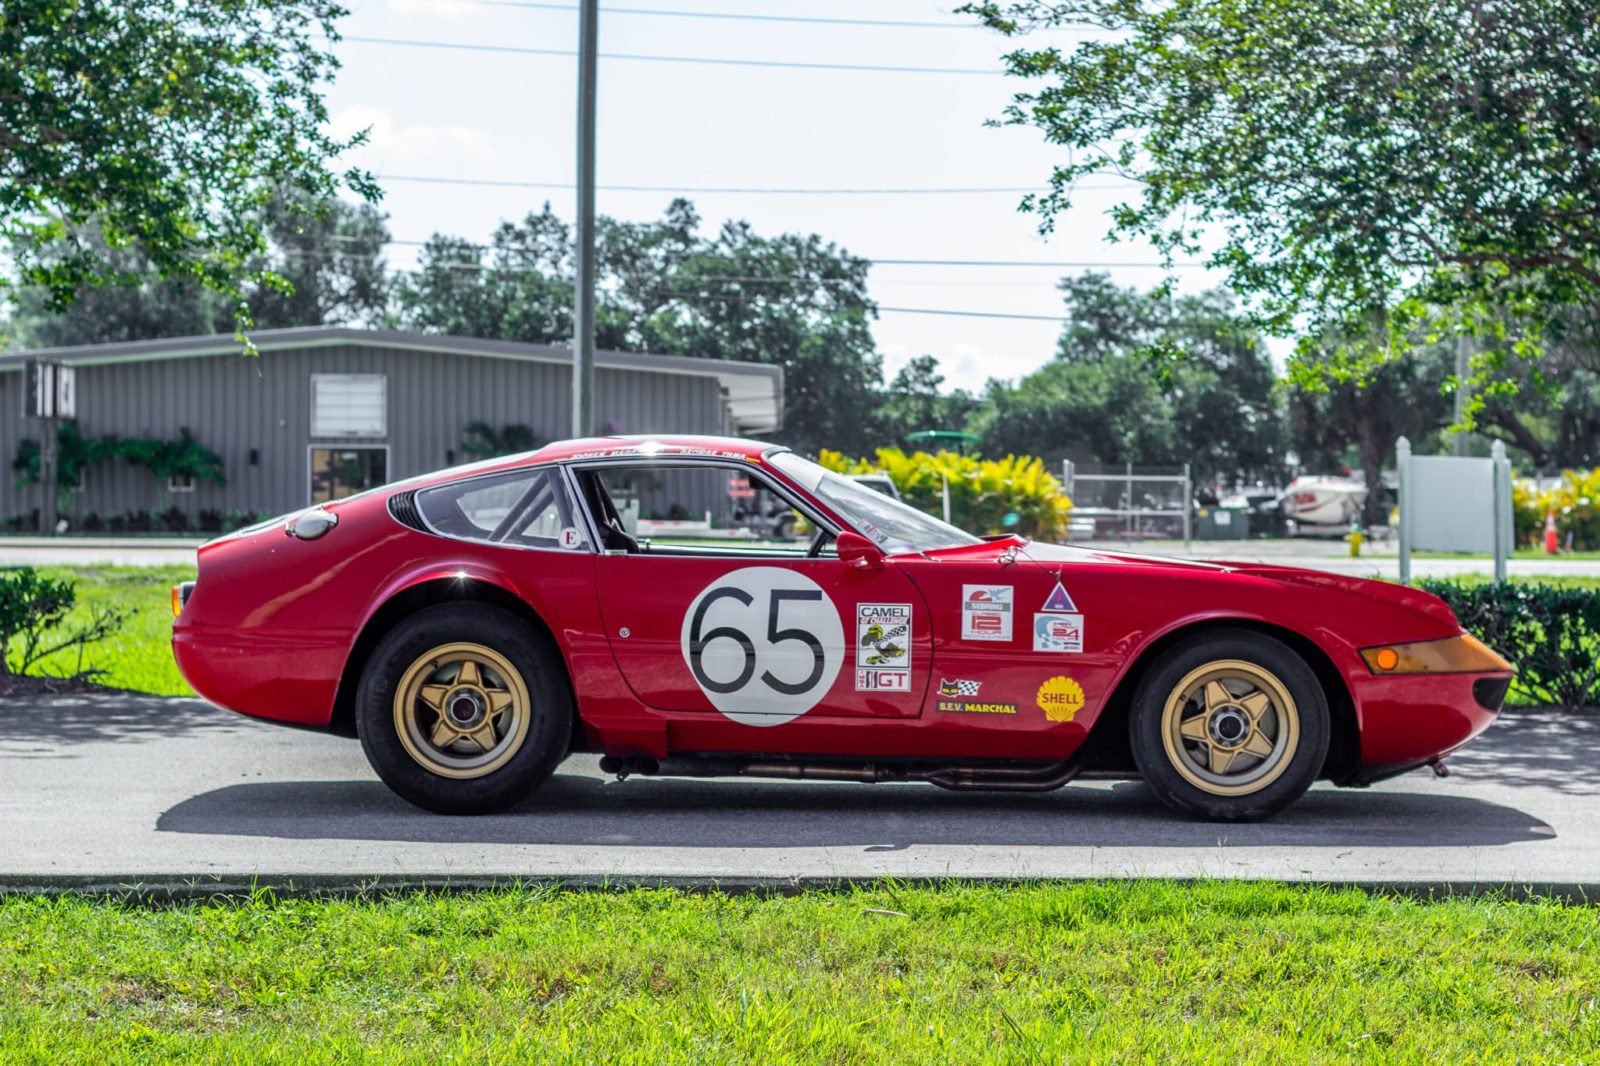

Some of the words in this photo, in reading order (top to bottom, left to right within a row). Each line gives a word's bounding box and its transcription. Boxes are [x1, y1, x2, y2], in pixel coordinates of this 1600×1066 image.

[566, 531, 576, 545] E
[861, 607, 909, 618] CAMEL
[689, 586, 825, 695] 65
[878, 672, 908, 687] GT
[1042, 692, 1080, 705] SHELL
[939, 702, 964, 712] S.E.V.
[964, 703, 1017, 714] MARCHAL
